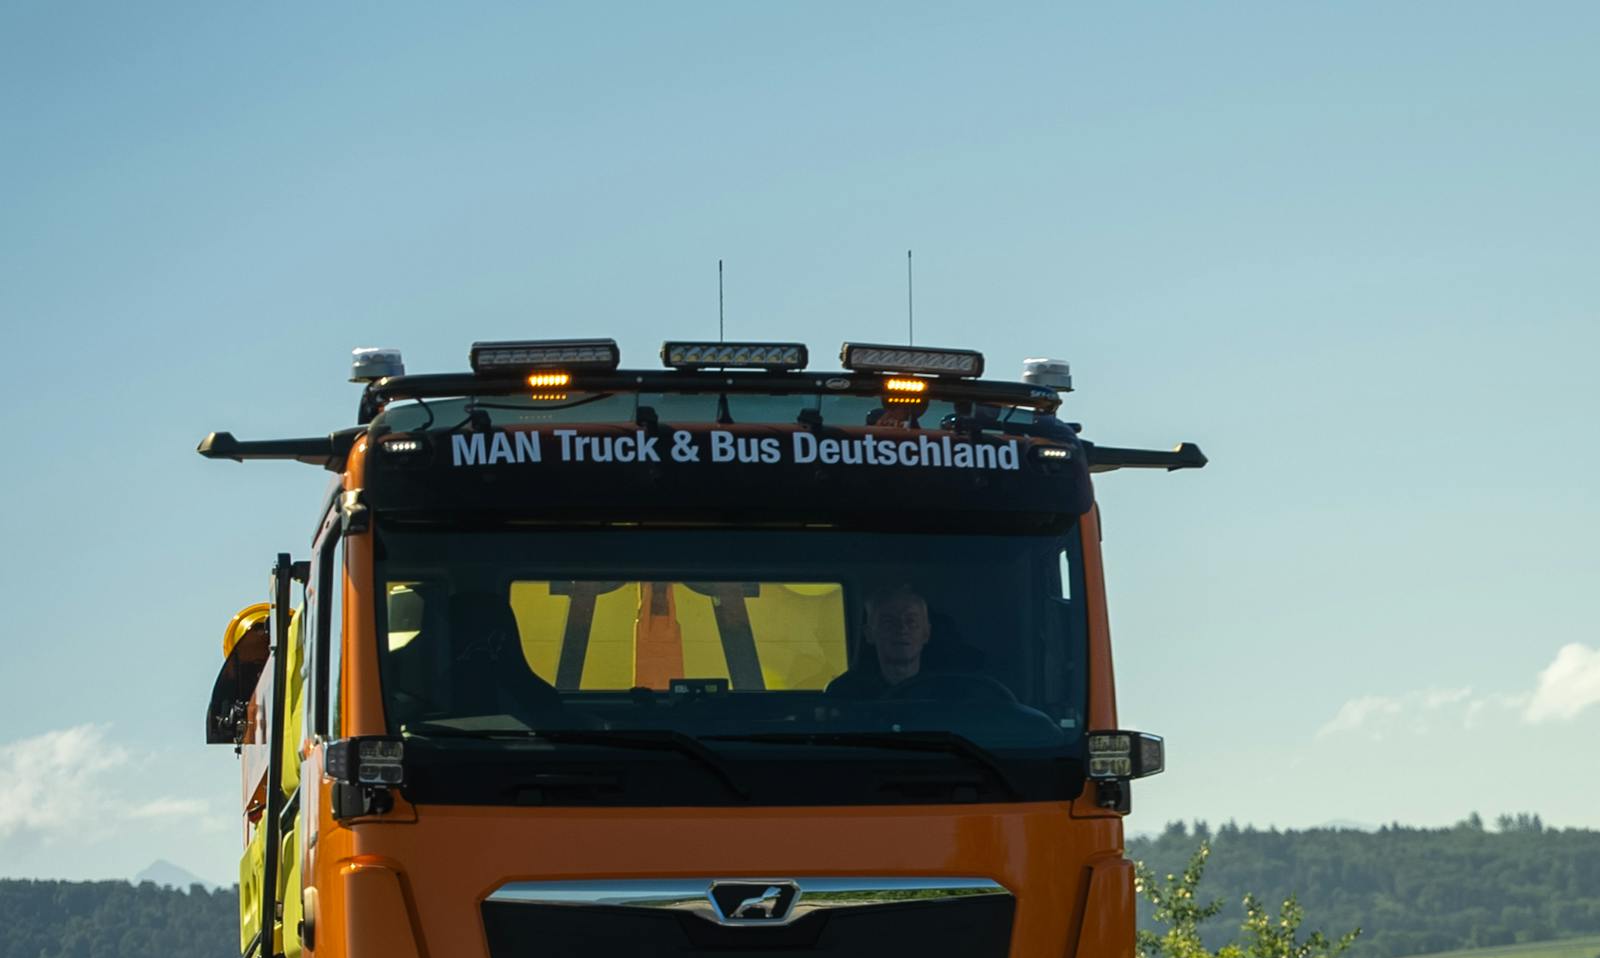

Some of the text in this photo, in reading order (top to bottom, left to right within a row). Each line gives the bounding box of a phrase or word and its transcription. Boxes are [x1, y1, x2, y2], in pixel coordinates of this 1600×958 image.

[452, 430, 1019, 470] MAN Truck & Bus Deutschland
